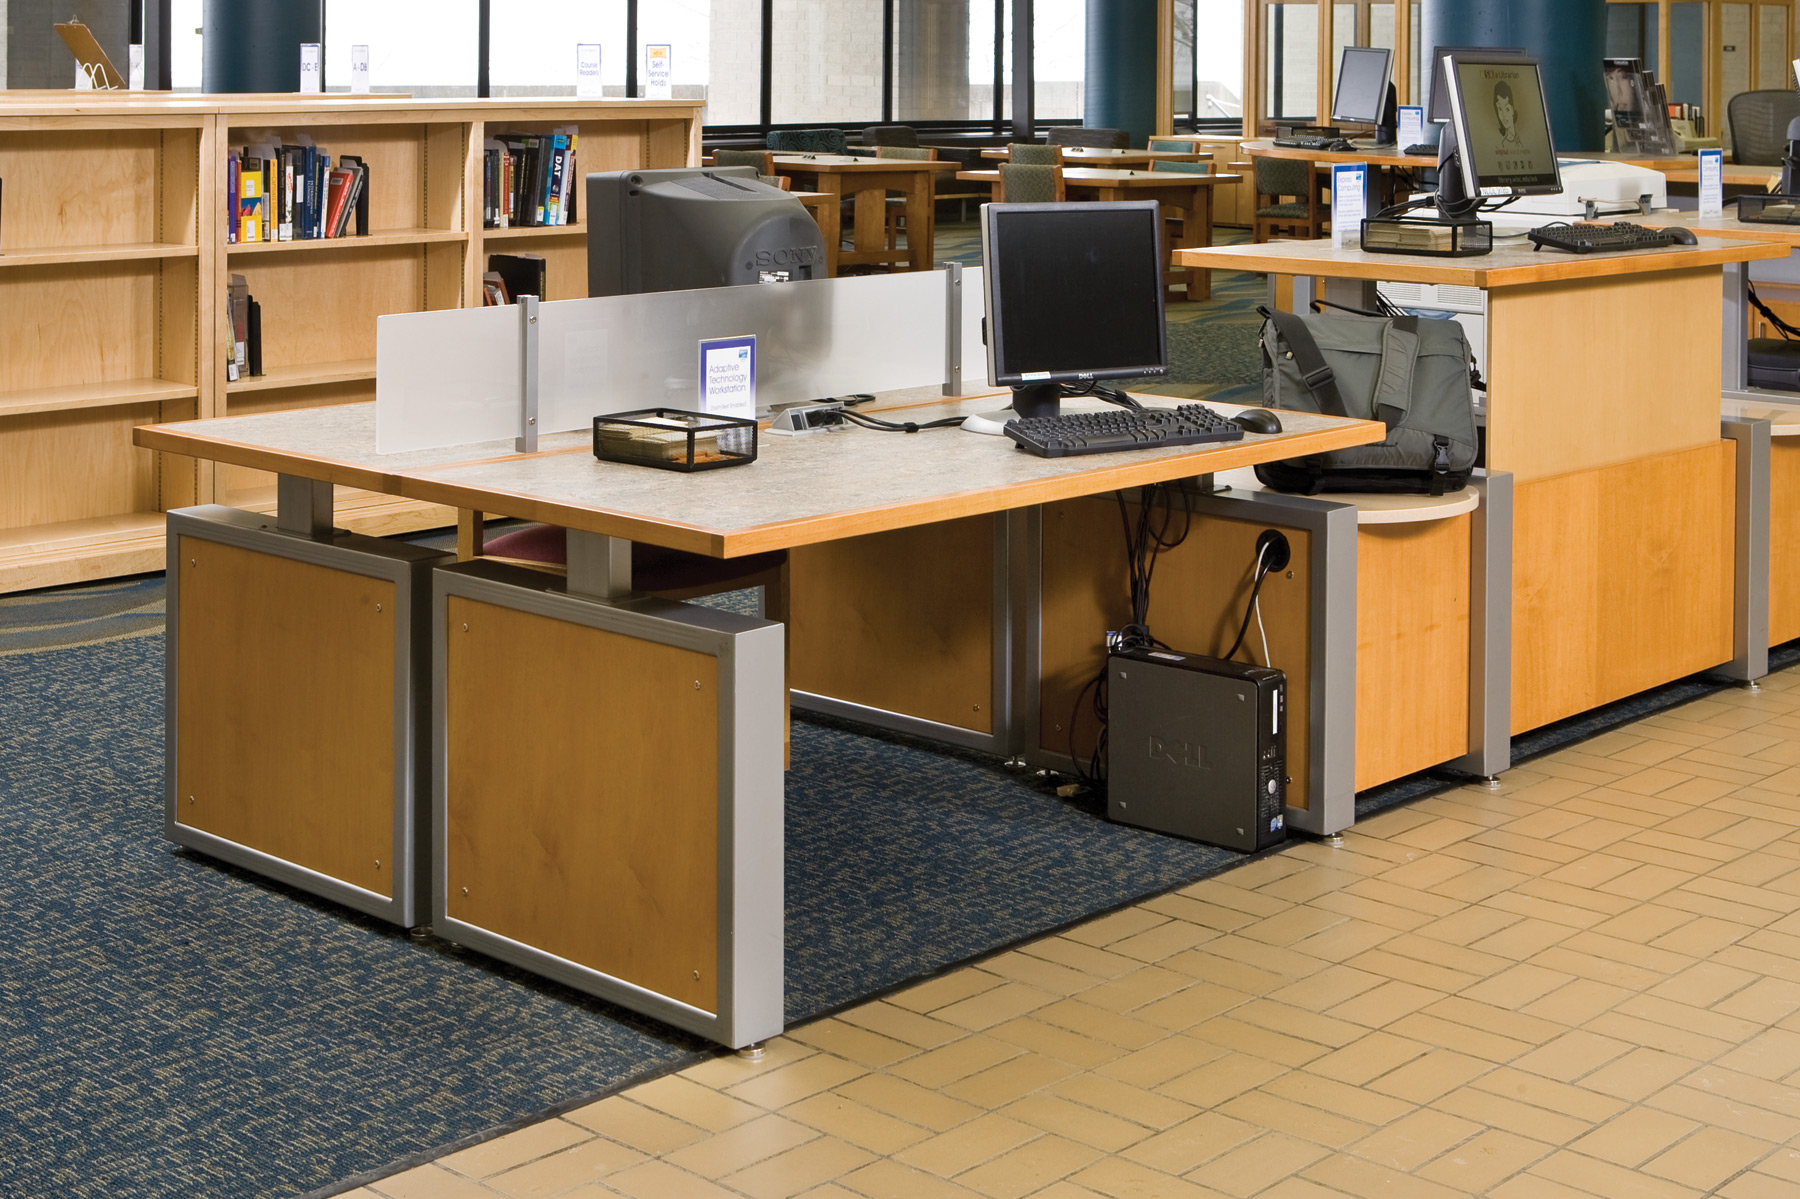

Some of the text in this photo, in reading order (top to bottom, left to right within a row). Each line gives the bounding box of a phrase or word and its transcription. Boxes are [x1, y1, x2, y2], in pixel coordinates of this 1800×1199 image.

[553, 155, 563, 177] DAT
[755, 245, 817, 267] SONY
[709, 363, 740, 374] Adaptive
[709, 374, 748, 385] Technology
[1078, 372, 1094, 380] DELL
[709, 384, 746, 395] Workstation
[1149, 735, 1213, 770] DELL
